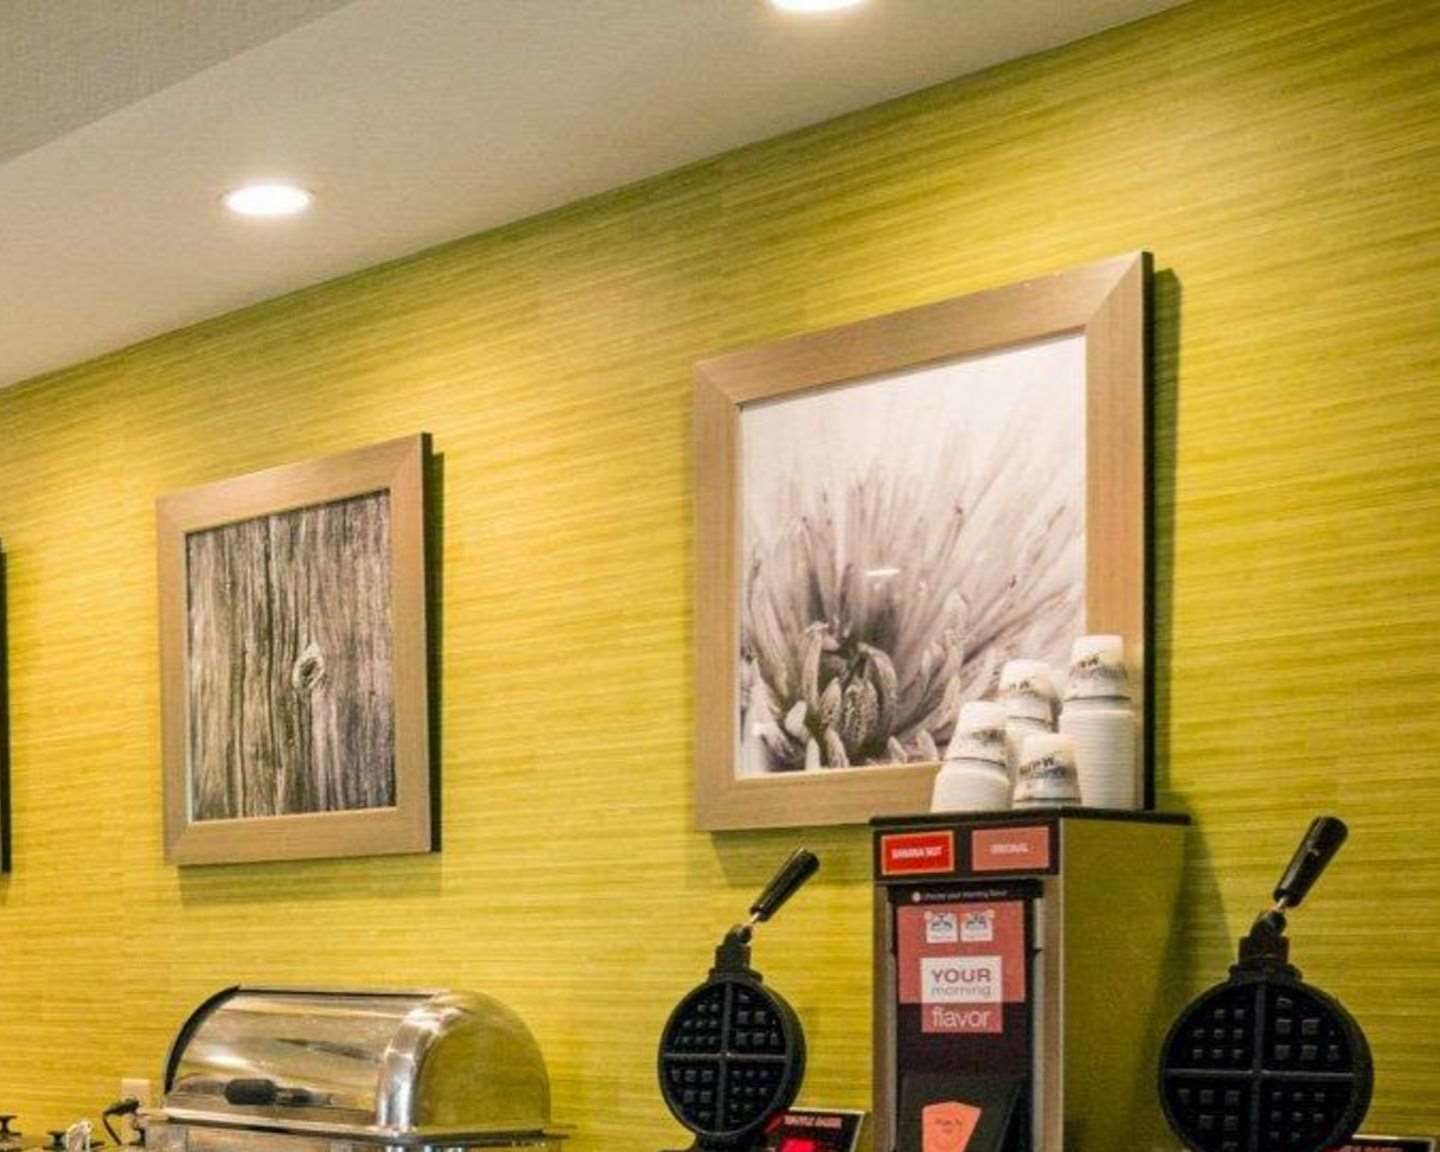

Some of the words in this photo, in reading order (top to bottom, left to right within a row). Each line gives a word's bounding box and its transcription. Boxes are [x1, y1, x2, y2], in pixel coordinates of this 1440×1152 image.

[931, 967, 991, 983] YOUR
[931, 985, 991, 999] morning
[931, 1006, 992, 1027] flavor
